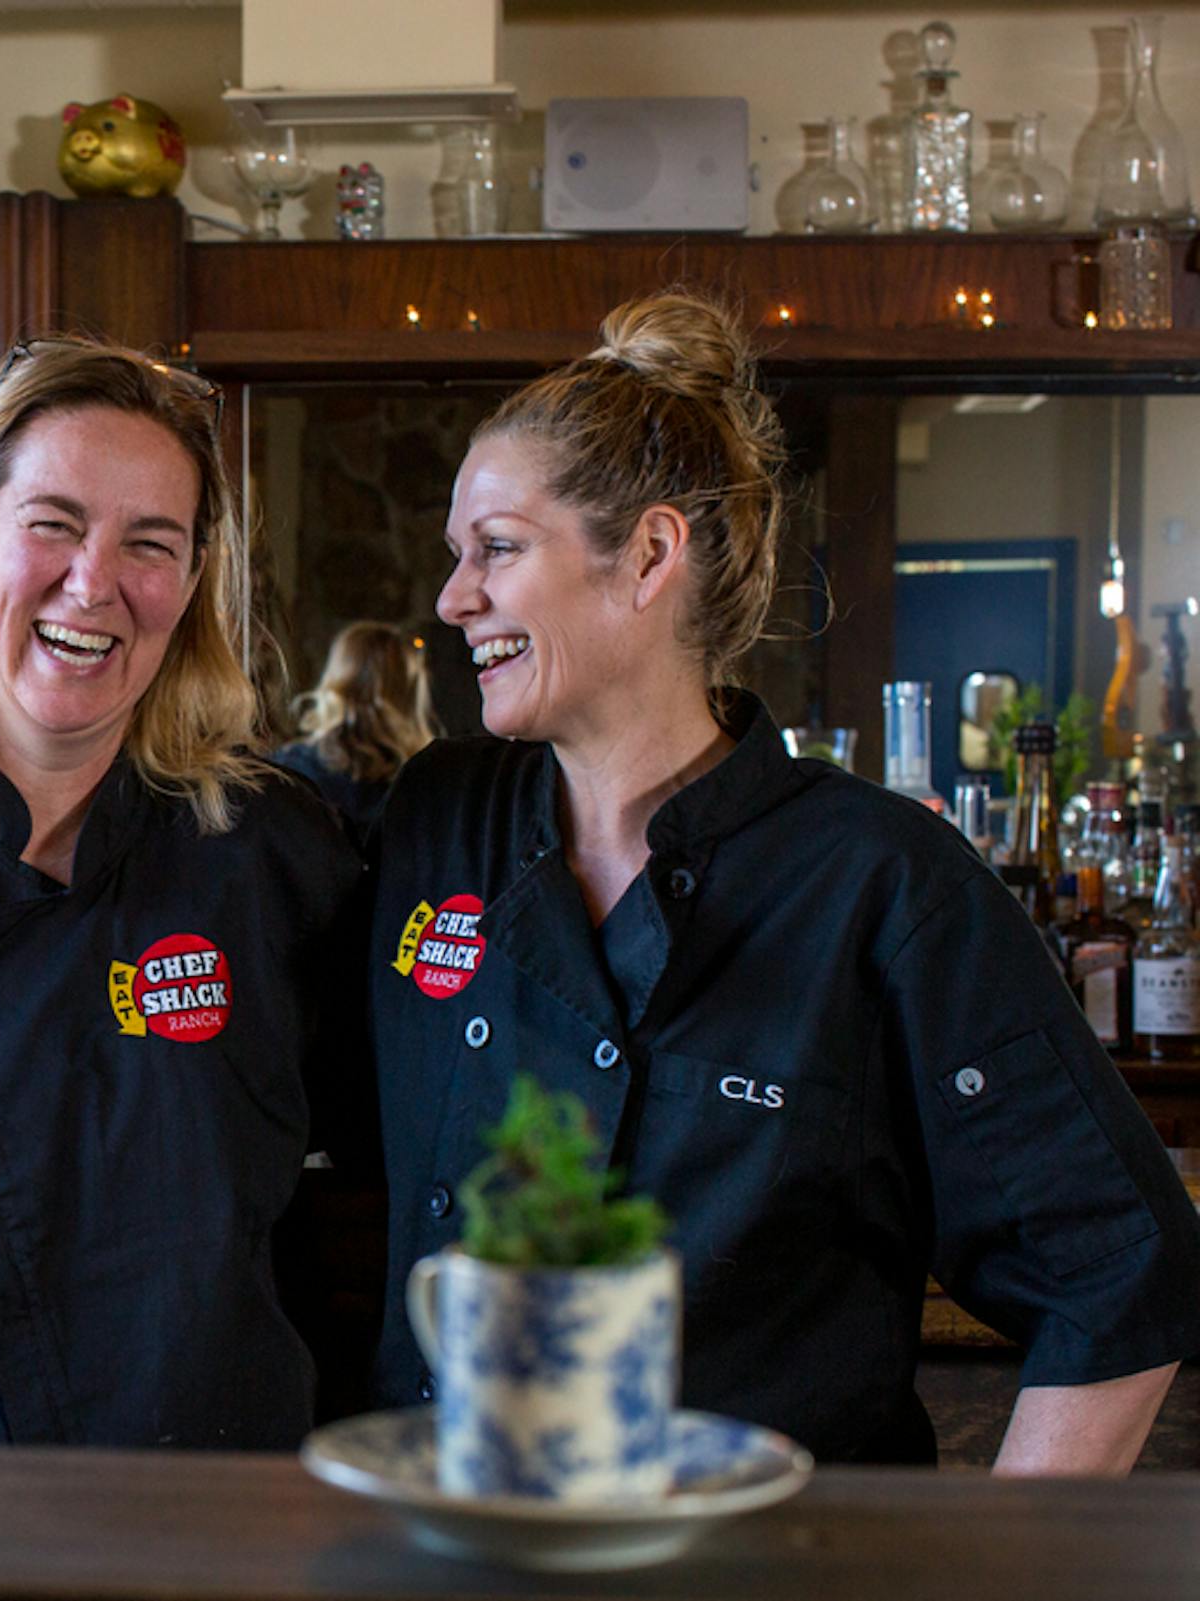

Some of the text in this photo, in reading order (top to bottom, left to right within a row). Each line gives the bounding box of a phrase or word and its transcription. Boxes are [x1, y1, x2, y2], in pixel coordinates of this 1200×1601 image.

[403, 912, 427, 957] EAT
[434, 911, 481, 938] CHE
[143, 950, 219, 983] CHEF
[418, 939, 480, 970] SHACK
[113, 970, 134, 1020] EAT
[422, 969, 463, 990] RANCH
[141, 982, 228, 1017] SHACK
[168, 1011, 222, 1032] RANCH
[719, 1075, 785, 1108] CLS
